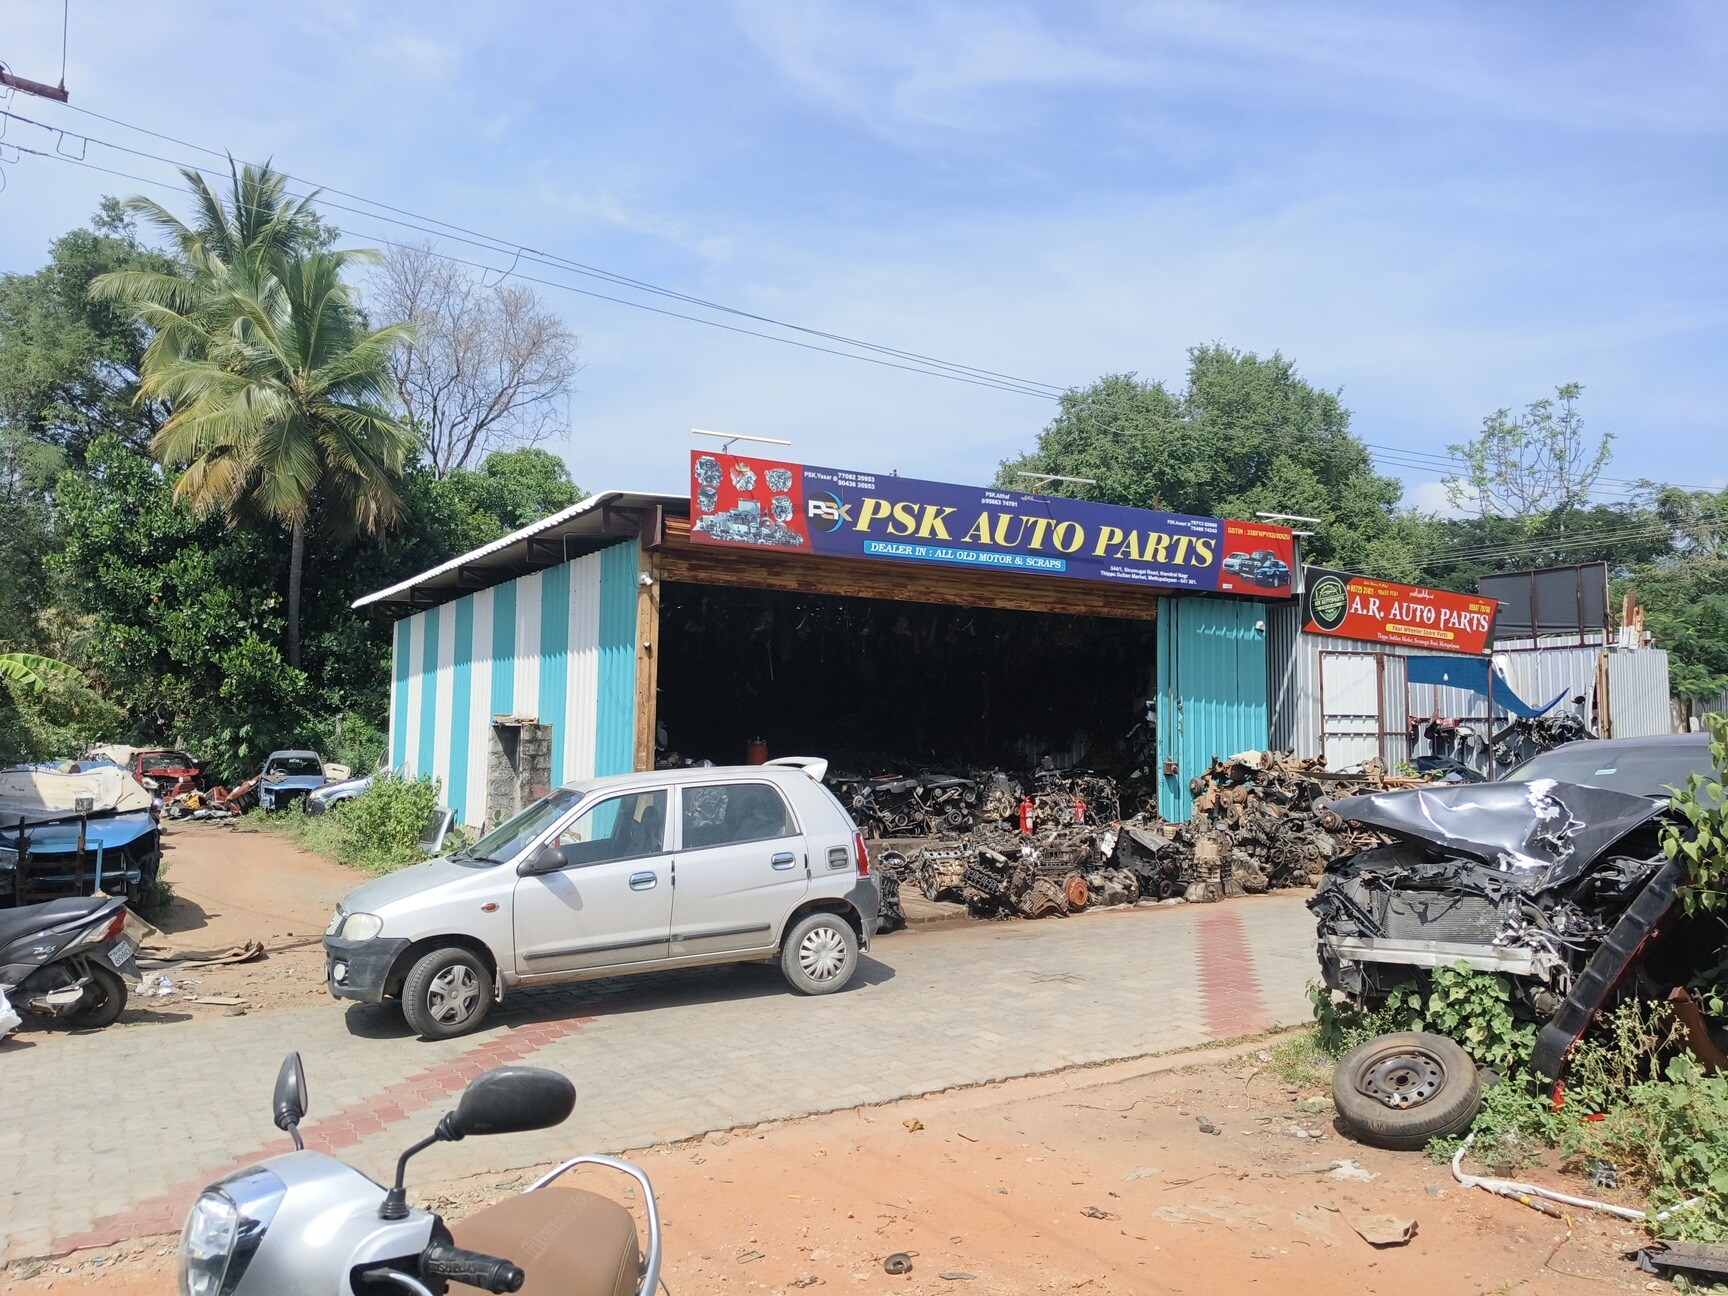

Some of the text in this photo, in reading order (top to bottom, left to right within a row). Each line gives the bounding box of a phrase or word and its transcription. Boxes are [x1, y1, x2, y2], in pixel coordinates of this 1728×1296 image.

[838, 472, 875, 483] 77082 35953
[857, 482, 875, 490] 35953
[808, 499, 853, 522] PSK
[852, 497, 1217, 568] PSK AUTO PARTS
[1227, 526, 1244, 535] GSTIN
[870, 542, 913, 555] DEALER
[915, 547, 927, 556] IN
[934, 549, 955, 559] ALL
[956, 552, 976, 561] OLD
[979, 553, 1013, 565] MOTOR
[1014, 557, 1025, 565] &
[1026, 557, 1062, 569] SCRAPS
[1349, 595, 1489, 634] A.R. AUTO PARTS
[1403, 626, 1423, 634] Wheeler
[1423, 629, 1436, 637] Spare
[114, 947, 132, 965] 8980
